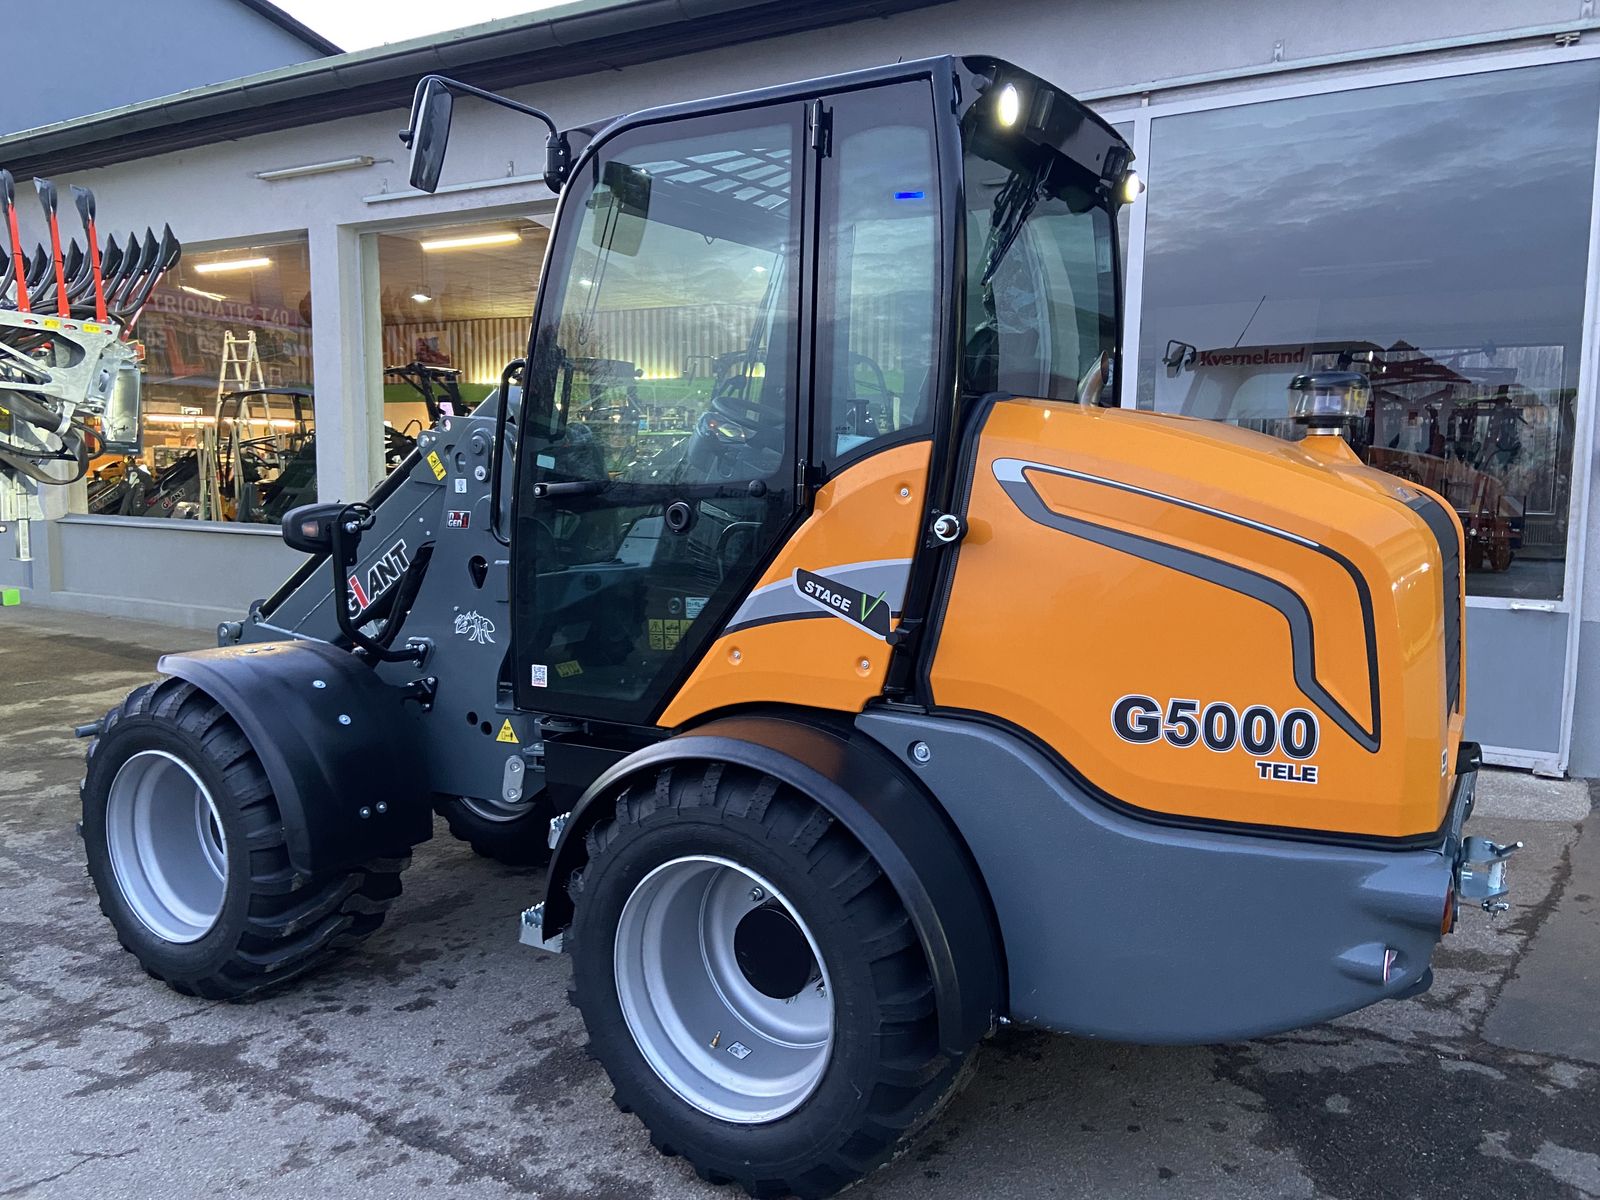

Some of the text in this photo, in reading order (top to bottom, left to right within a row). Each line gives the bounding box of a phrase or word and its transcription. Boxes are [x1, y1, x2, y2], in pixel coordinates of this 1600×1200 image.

[152, 293, 254, 320] TRIOMATIC
[1200, 347, 1305, 366] Kverneland
[804, 580, 852, 612] STAGE
[1111, 694, 1320, 760] G5000
[1255, 760, 1318, 784] TELE
